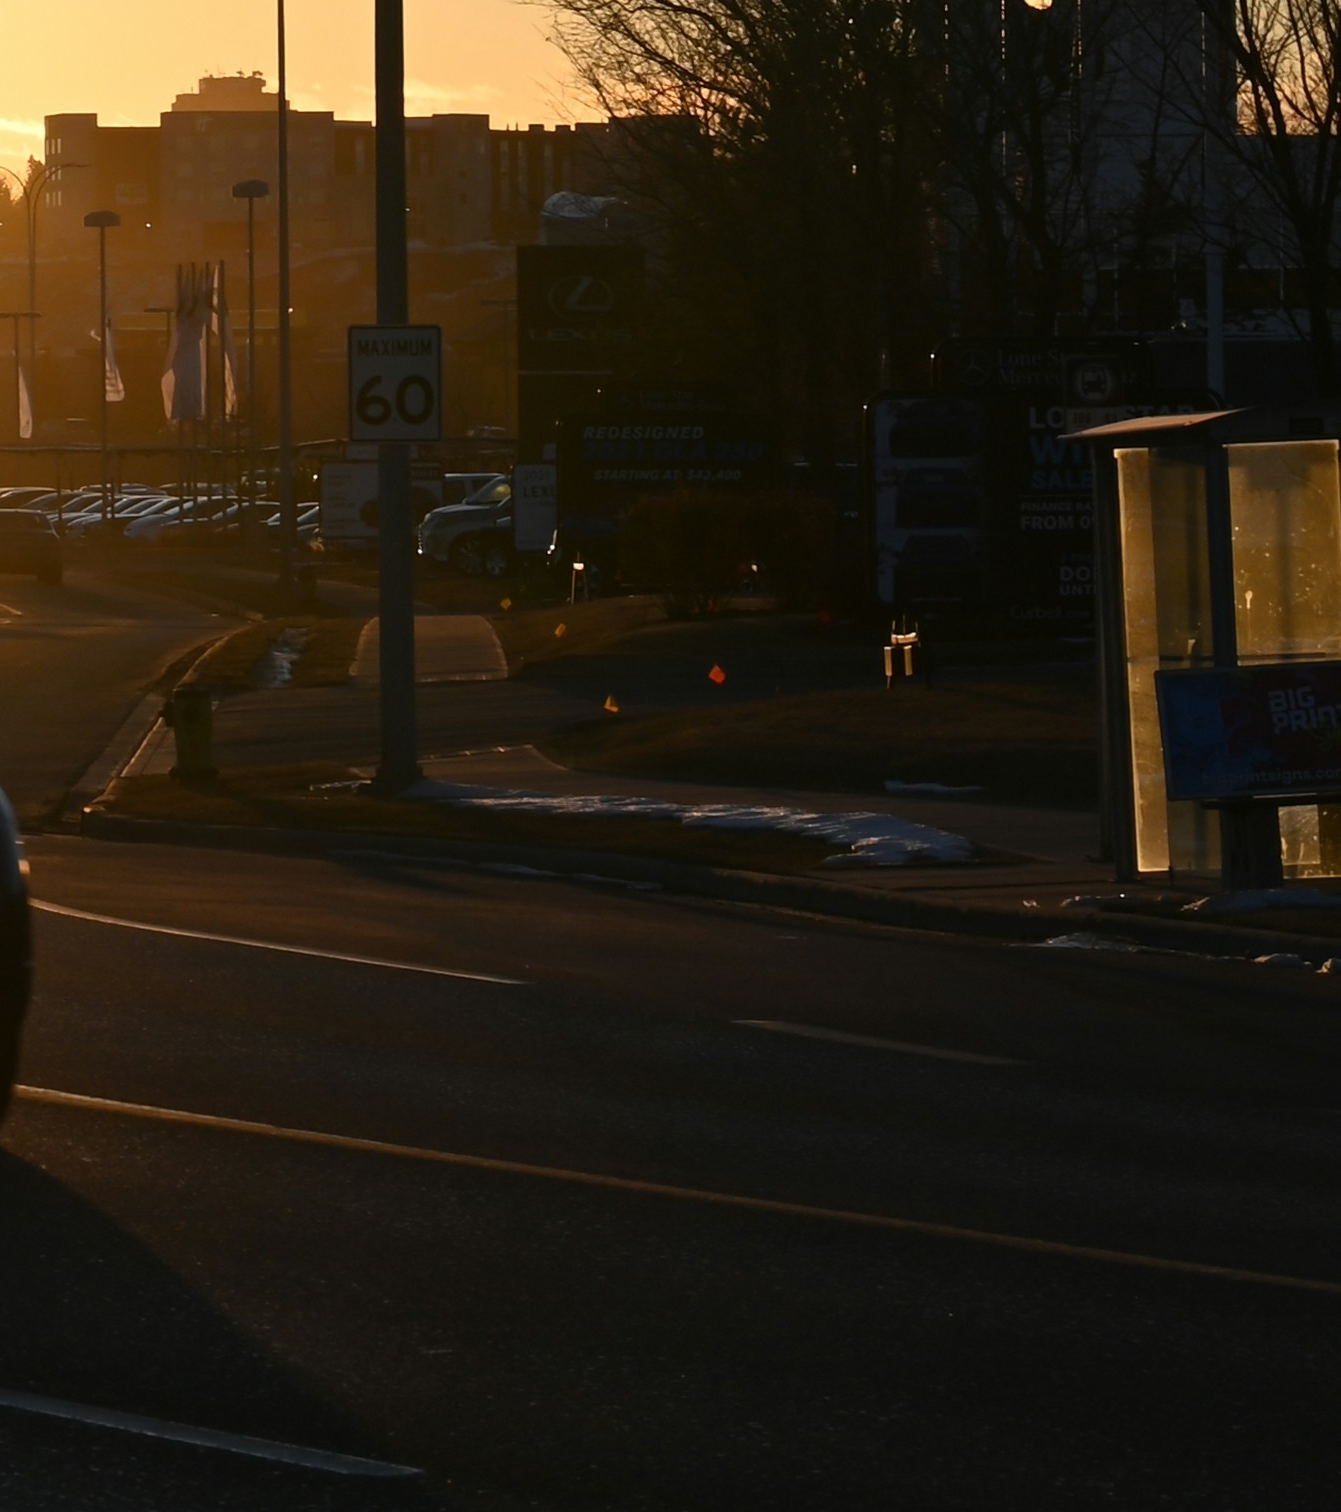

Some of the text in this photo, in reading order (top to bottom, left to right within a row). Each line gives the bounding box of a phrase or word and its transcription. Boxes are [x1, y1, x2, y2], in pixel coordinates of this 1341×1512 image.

[357, 339, 433, 356] MAXIMUM
[997, 348, 1041, 367] Lone
[357, 375, 433, 426] 60
[583, 425, 705, 440] REDESIGNED
[593, 469, 660, 481] STARTING
[1020, 501, 1072, 512] FINANCE
[1020, 515, 1095, 530] FROM 0
[1059, 583, 1093, 596] UNT
[1267, 686, 1315, 712] BIG
